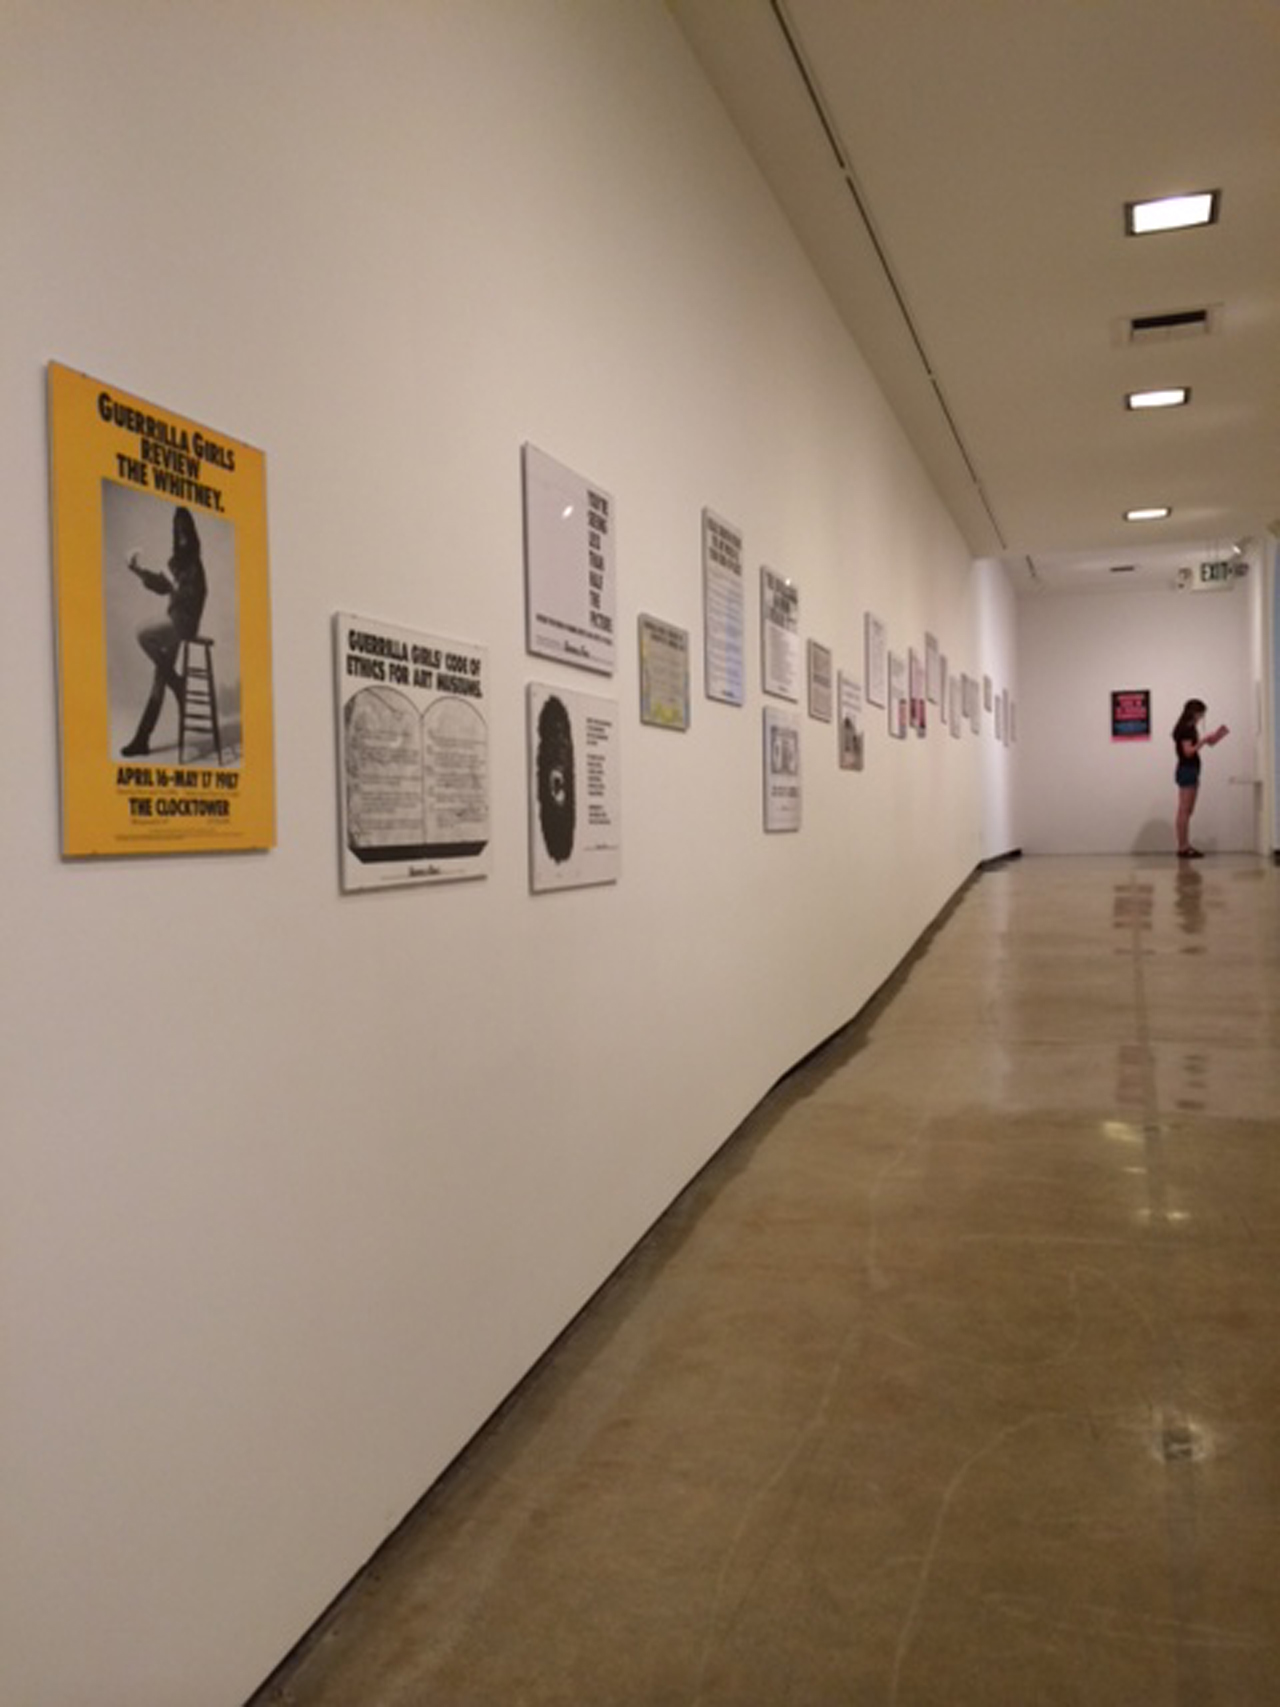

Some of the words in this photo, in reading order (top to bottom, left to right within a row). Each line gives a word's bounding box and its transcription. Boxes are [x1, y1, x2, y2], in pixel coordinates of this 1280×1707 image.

[140, 438, 200, 480] REVIEW
[192, 432, 235, 471] GIRLS
[116, 453, 148, 486] THE
[1201, 562, 1228, 582] EXIT
[348, 629, 409, 663] GUERRILLA
[445, 652, 468, 675] CODE
[470, 658, 482, 677] OF
[346, 654, 385, 681] ETHICS
[389, 662, 409, 686] FOR
[413, 668, 433, 689] ART
[117, 767, 154, 787] APRIL
[129, 797, 152, 816] THE
